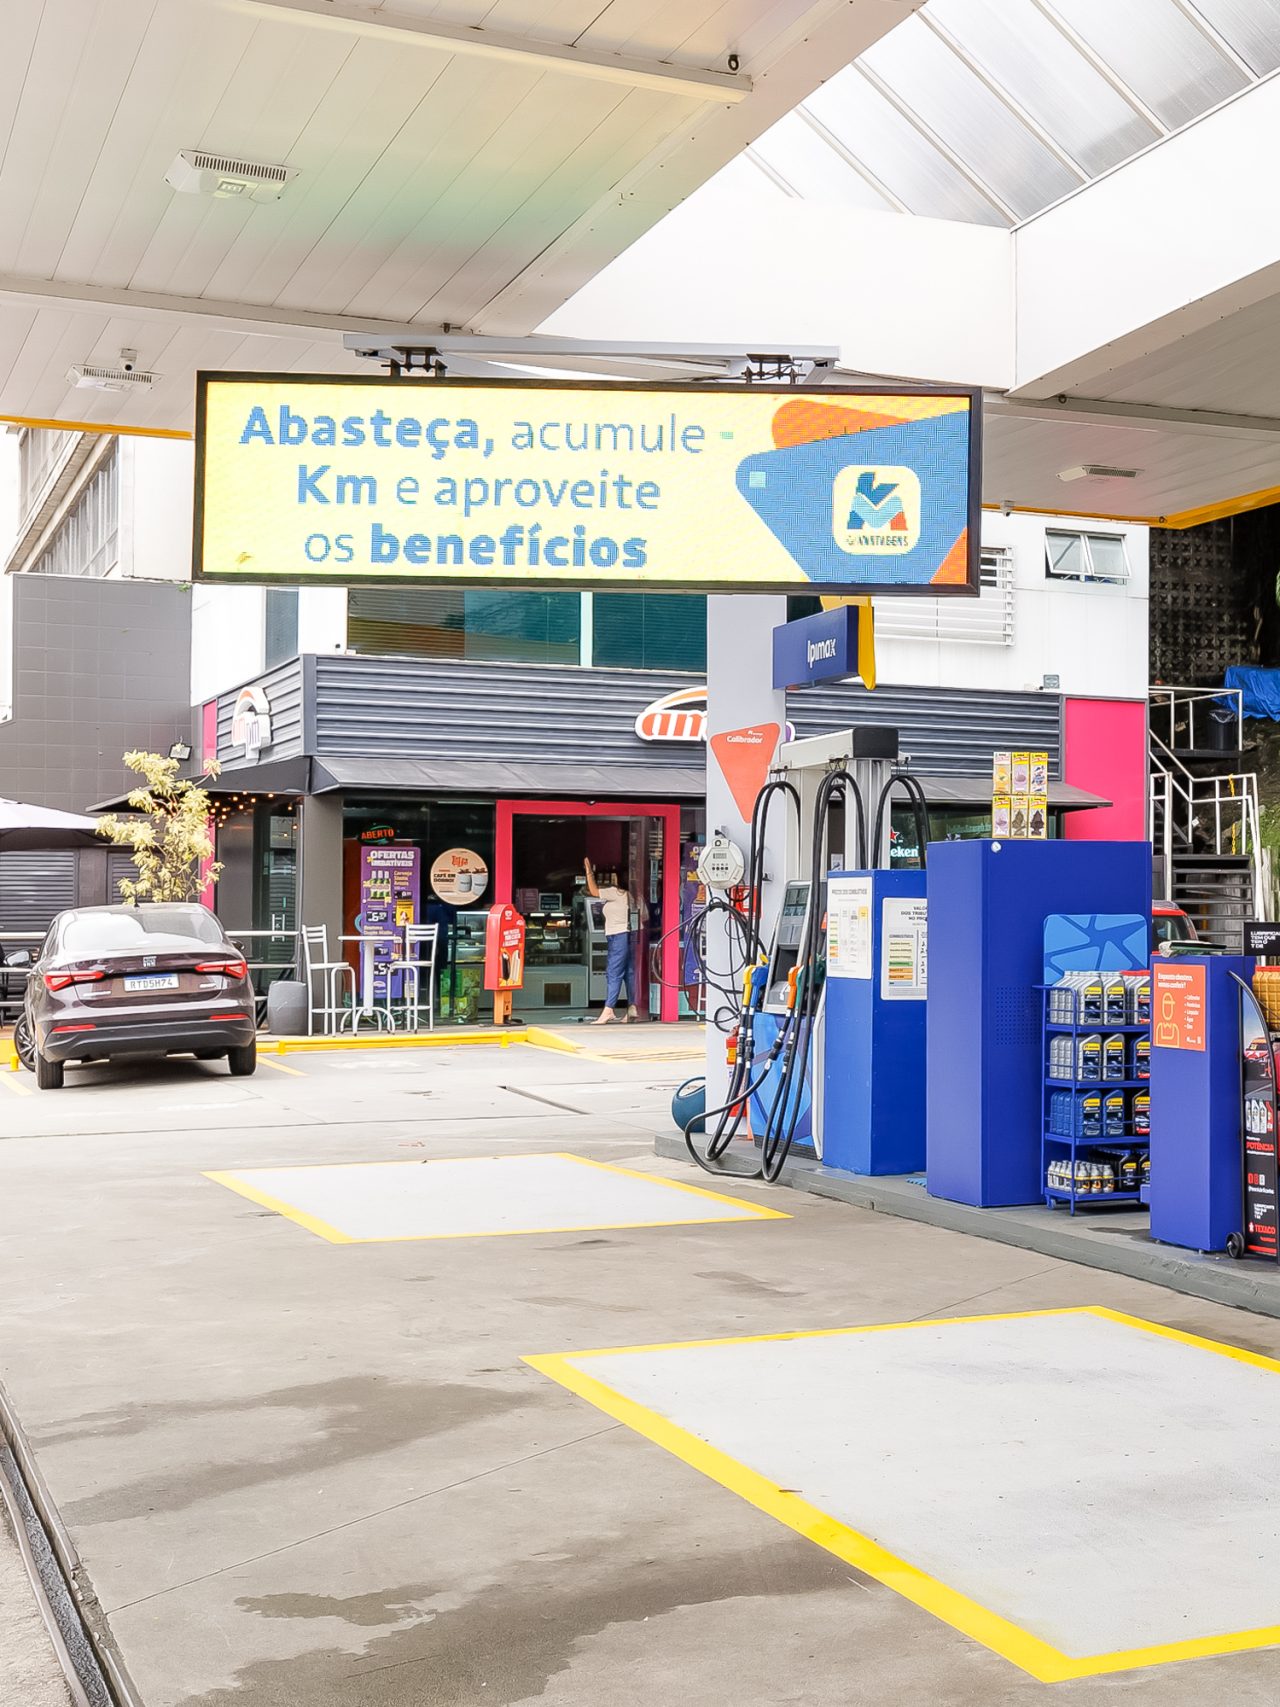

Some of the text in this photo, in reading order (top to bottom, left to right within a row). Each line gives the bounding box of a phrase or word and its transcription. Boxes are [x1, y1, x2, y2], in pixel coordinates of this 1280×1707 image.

[238, 405, 705, 460] Abasteça, acumule
[298, 465, 662, 517] Km e aproveite
[305, 522, 649, 568] os benefícios
[807, 637, 836, 668] Ipimax
[727, 735, 763, 744] Calibrador
[361, 829, 394, 839] ABERTO
[370, 851, 414, 859] OFERTAS
[890, 846, 919, 857] eken
